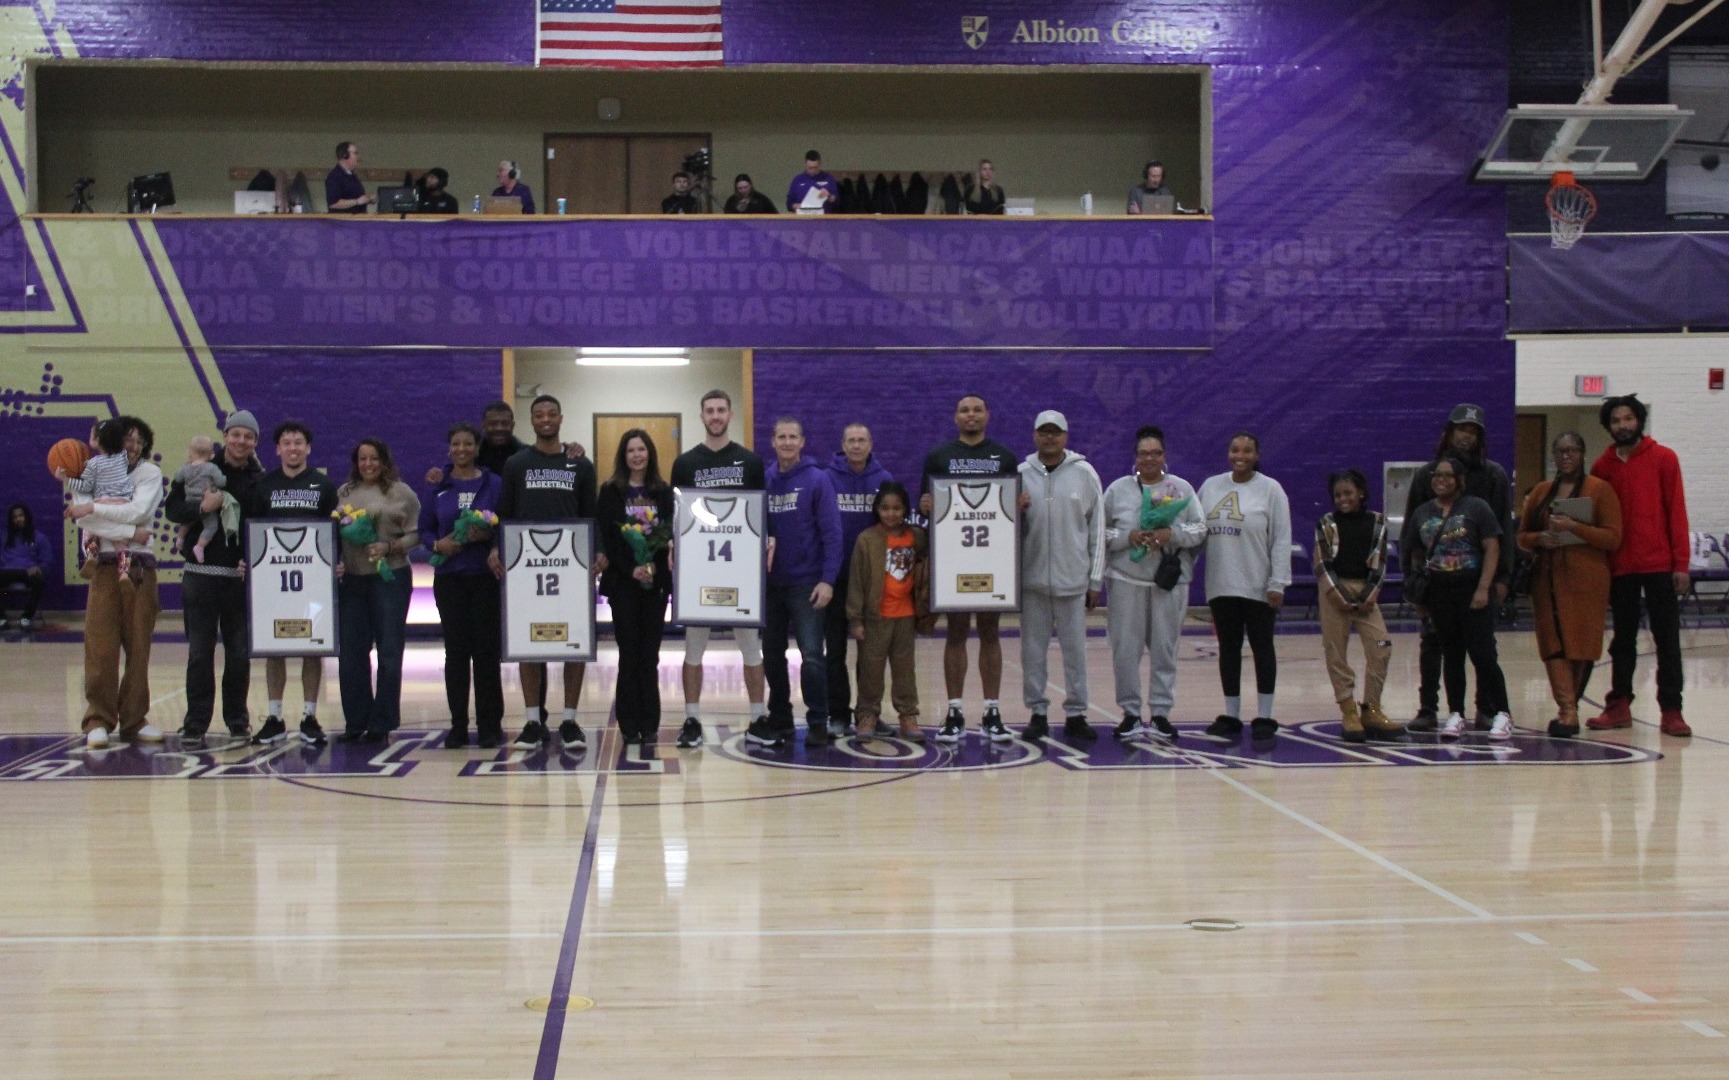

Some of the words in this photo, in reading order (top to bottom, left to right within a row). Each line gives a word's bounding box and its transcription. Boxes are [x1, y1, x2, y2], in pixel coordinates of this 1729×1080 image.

[1011, 20, 1099, 44] Albion
[1111, 20, 1212, 52] College
[333, 227, 601, 259] BASKETBALL
[624, 229, 882, 260] VOLLEYBALL
[906, 231, 1023, 263] NCAA
[1050, 235, 1161, 265] MIAA
[282, 260, 440, 290] ALBION
[453, 261, 637, 291] COLLEGE
[661, 263, 843, 292] BRITONS
[869, 264, 1000, 295] MEN'S
[1014, 266, 1044, 296] &
[1056, 267, 1251, 298] WOMEN'S
[302, 294, 437, 325] MEN'S
[450, 295, 482, 325] &
[494, 296, 697, 326] WOMEN'S
[712, 297, 974, 328] BASKETBALL
[997, 299, 1246, 331] VOLLEYBALL
[948, 459, 1000, 472] ALBION
[525, 468, 577, 482] ALBION
[695, 466, 744, 481] ALBION
[525, 480, 575, 490] BASKETBALL
[695, 477, 745, 488] BASKETBALL
[270, 489, 320, 502] ALBION
[270, 500, 319, 509] BASKETBALL
[1207, 490, 1245, 521] A
[954, 512, 997, 521] ALBION
[961, 525, 989, 548] 32
[708, 540, 732, 562] 14
[269, 555, 313, 565] ALBION
[525, 558, 570, 567] ALBION
[280, 569, 304, 592] 10
[536, 572, 560, 596] 12
